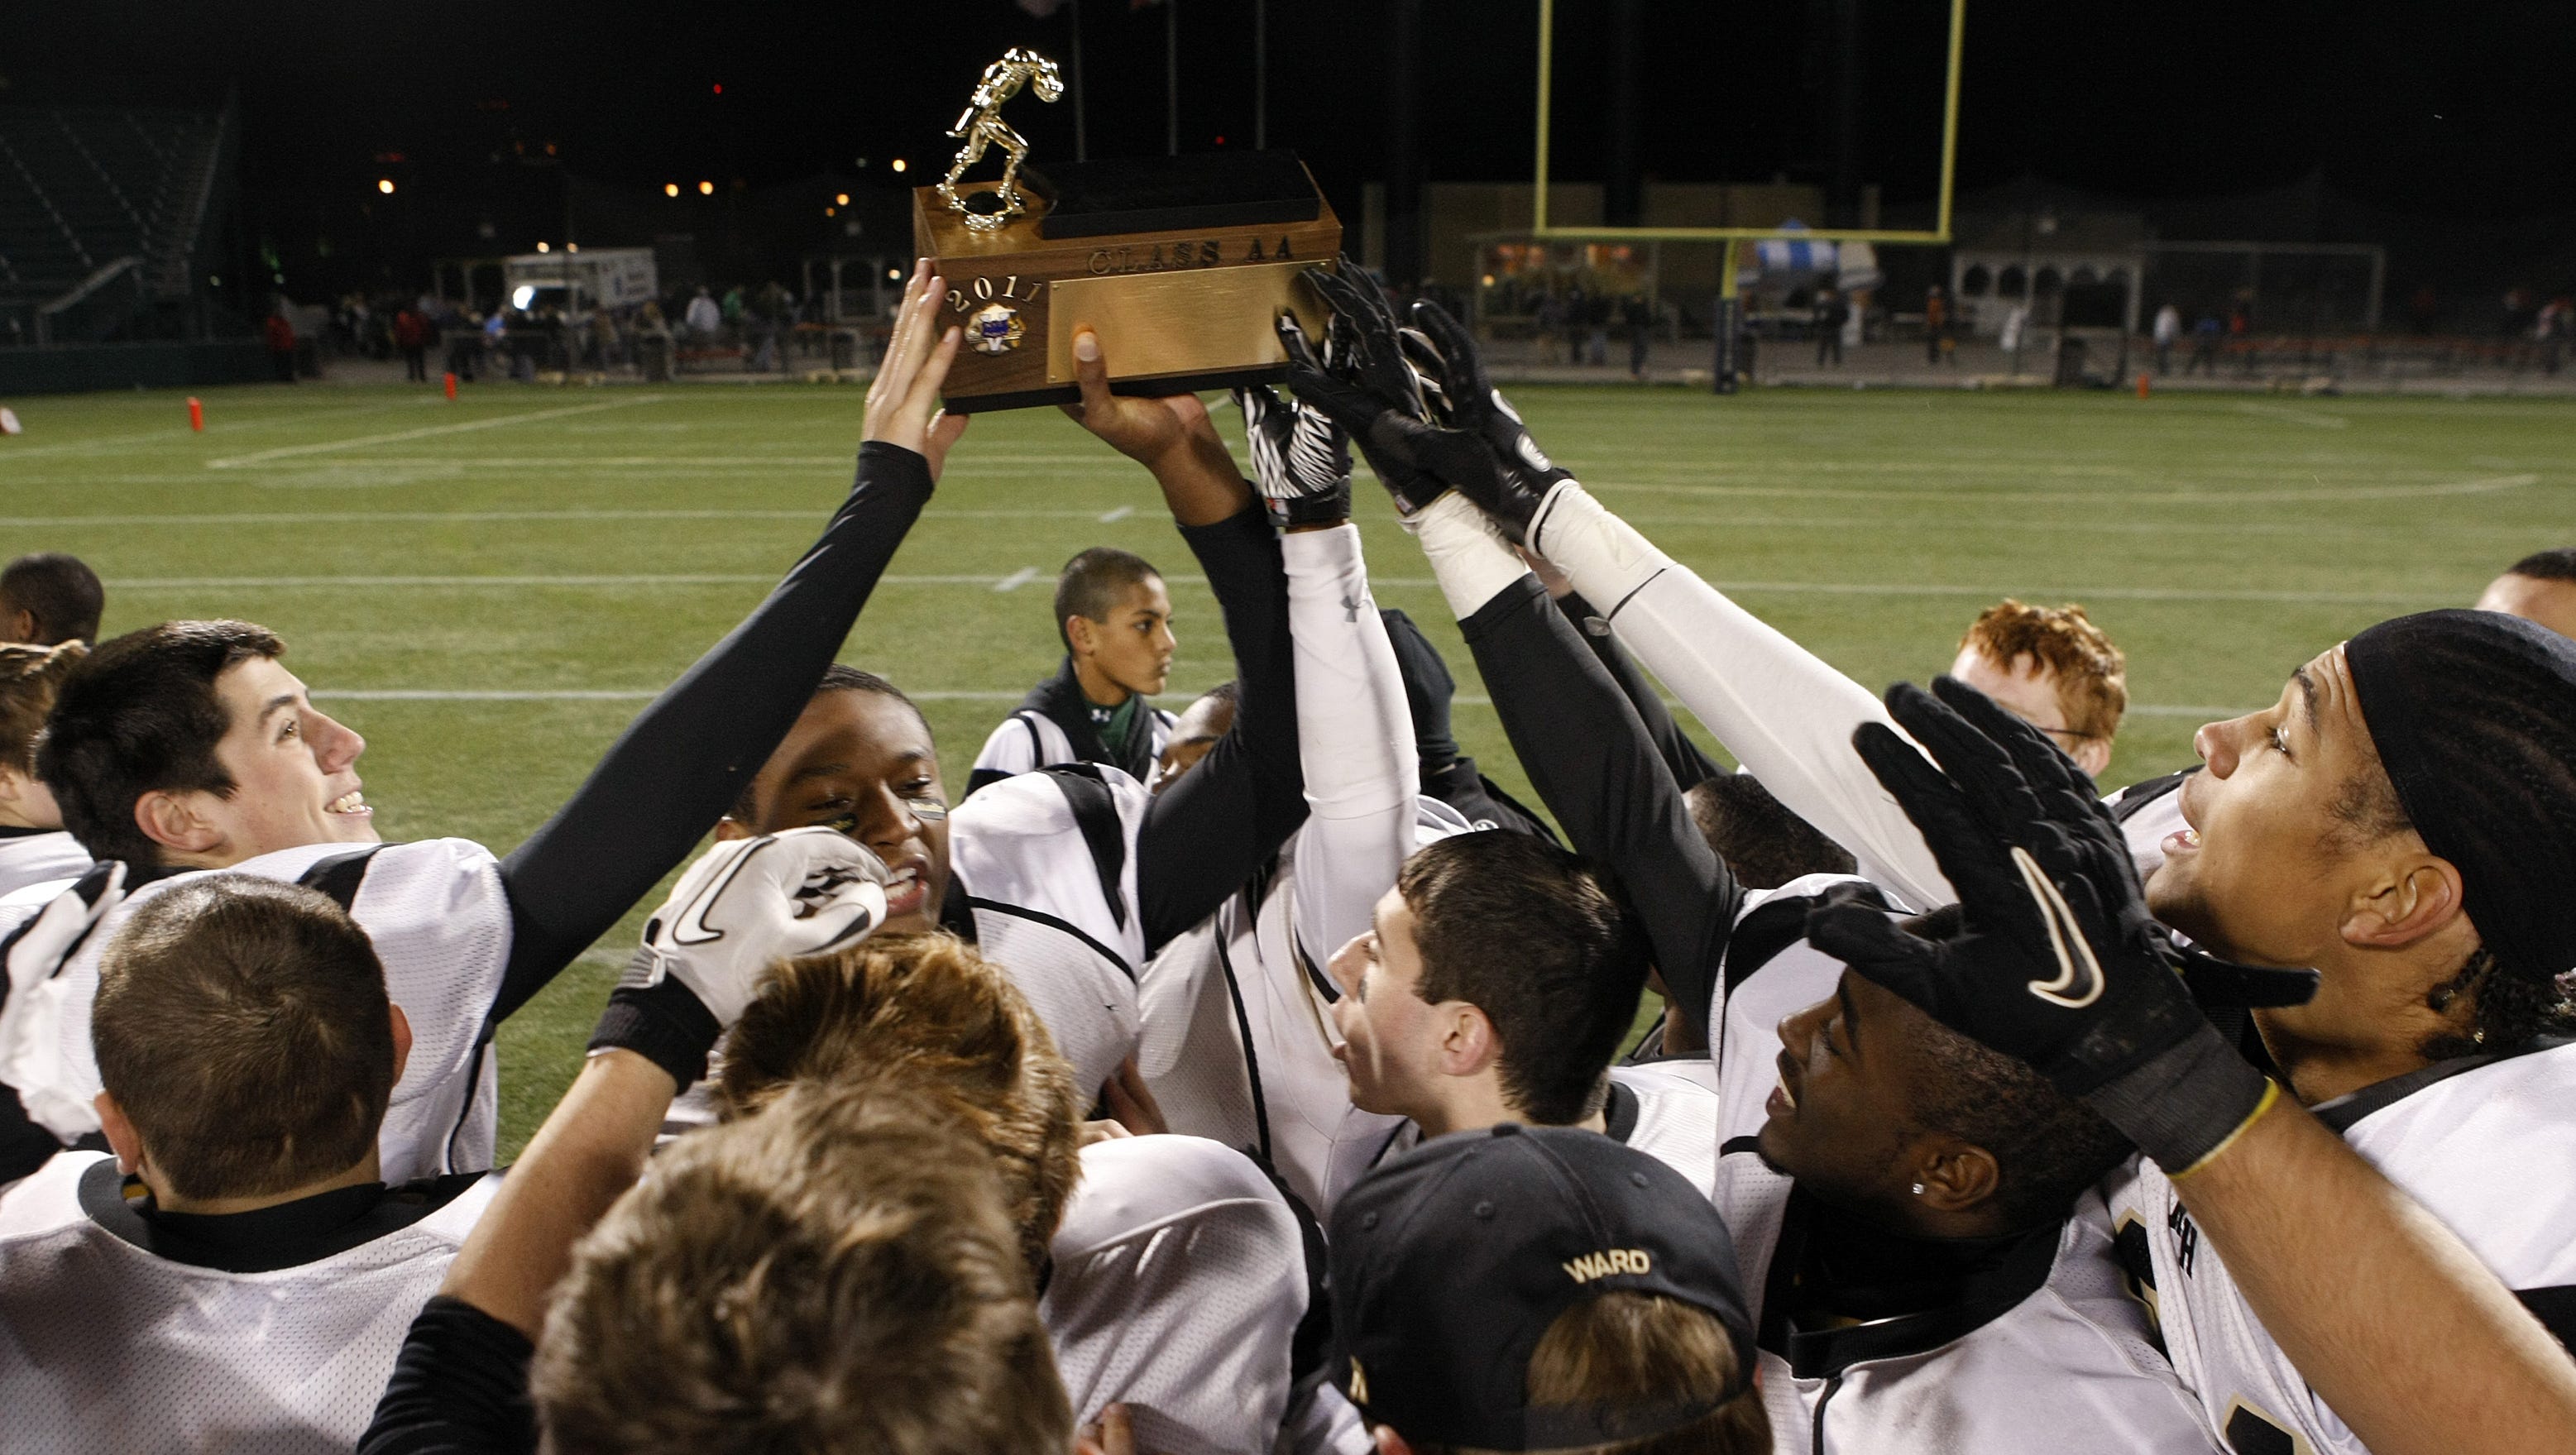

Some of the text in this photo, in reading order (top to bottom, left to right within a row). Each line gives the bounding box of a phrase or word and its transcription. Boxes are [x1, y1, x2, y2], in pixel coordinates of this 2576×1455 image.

[1087, 236, 1293, 275] CLASS AA
[946, 275, 1042, 313] 2011
[1562, 1248, 1650, 1284] WARD
